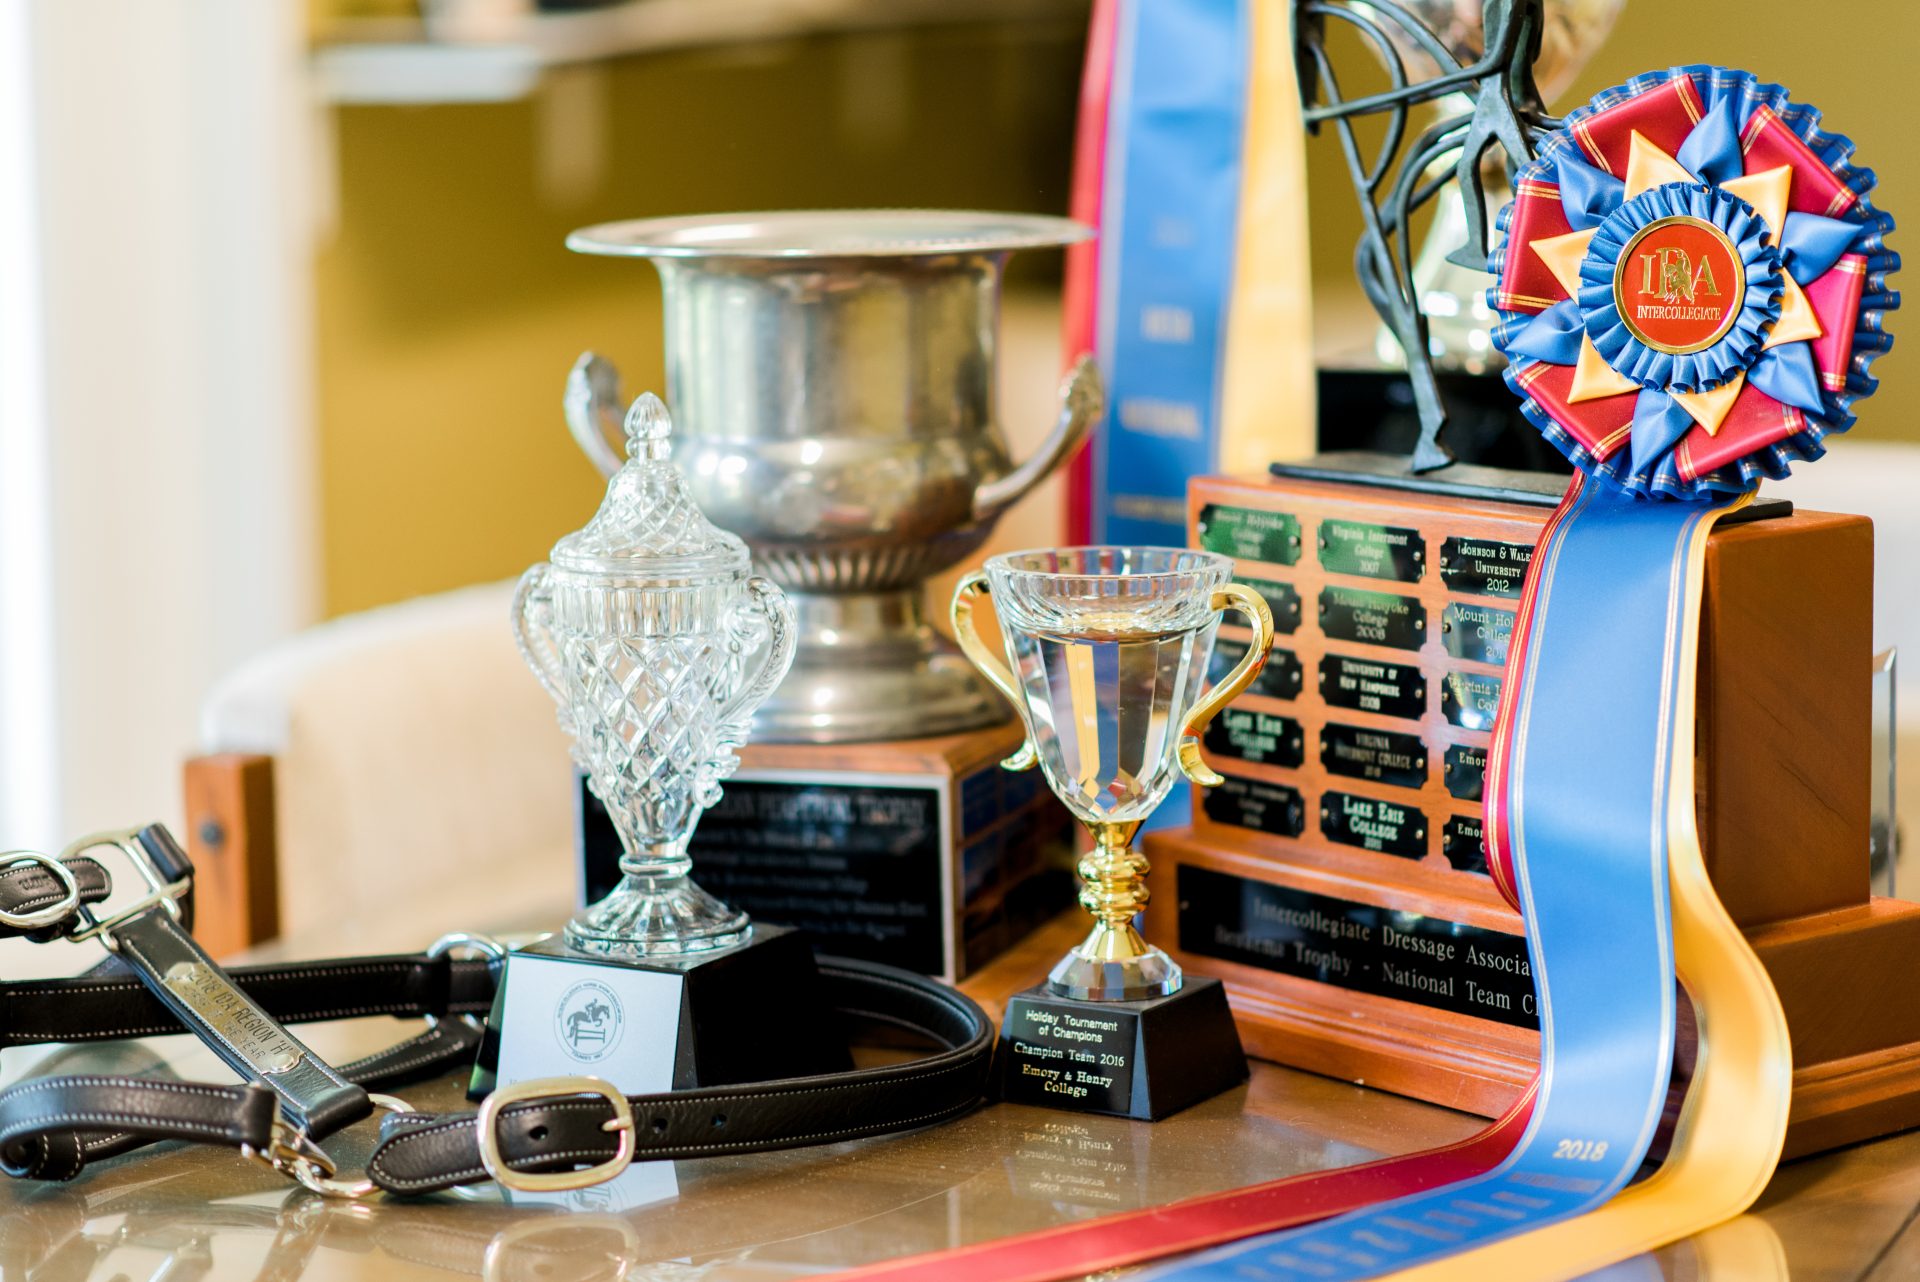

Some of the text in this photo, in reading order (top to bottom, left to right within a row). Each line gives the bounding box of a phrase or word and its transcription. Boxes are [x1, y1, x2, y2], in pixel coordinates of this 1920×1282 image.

[1637, 305, 1721, 321] INTERCOLLEGIATE
[1332, 525, 1364, 541] Virginia
[1499, 546, 1507, 559] &
[1486, 578, 1510, 593] 2012
[1352, 609, 1389, 627] College
[1453, 606, 1489, 624] Mount
[1477, 626, 1512, 646] Colleg
[1459, 752, 1486, 767] Emor
[1253, 898, 1371, 941] Intercollegiate
[1382, 925, 1456, 961] Dressage
[1465, 944, 1532, 977] Associa
[1294, 940, 1352, 977] Trophy
[1382, 961, 1454, 997] National
[1465, 980, 1511, 1010] Team
[231, 1007, 278, 1043] REGION
[1025, 1009, 1118, 1032] Holiday Tournament
[1038, 1025, 1103, 1043] of Champions
[1014, 1041, 1125, 1067] Champion Team 2016
[1022, 1063, 1113, 1088] Emory & Henry
[1044, 1080, 1088, 1097] College
[1552, 1138, 1609, 1162] 2018
